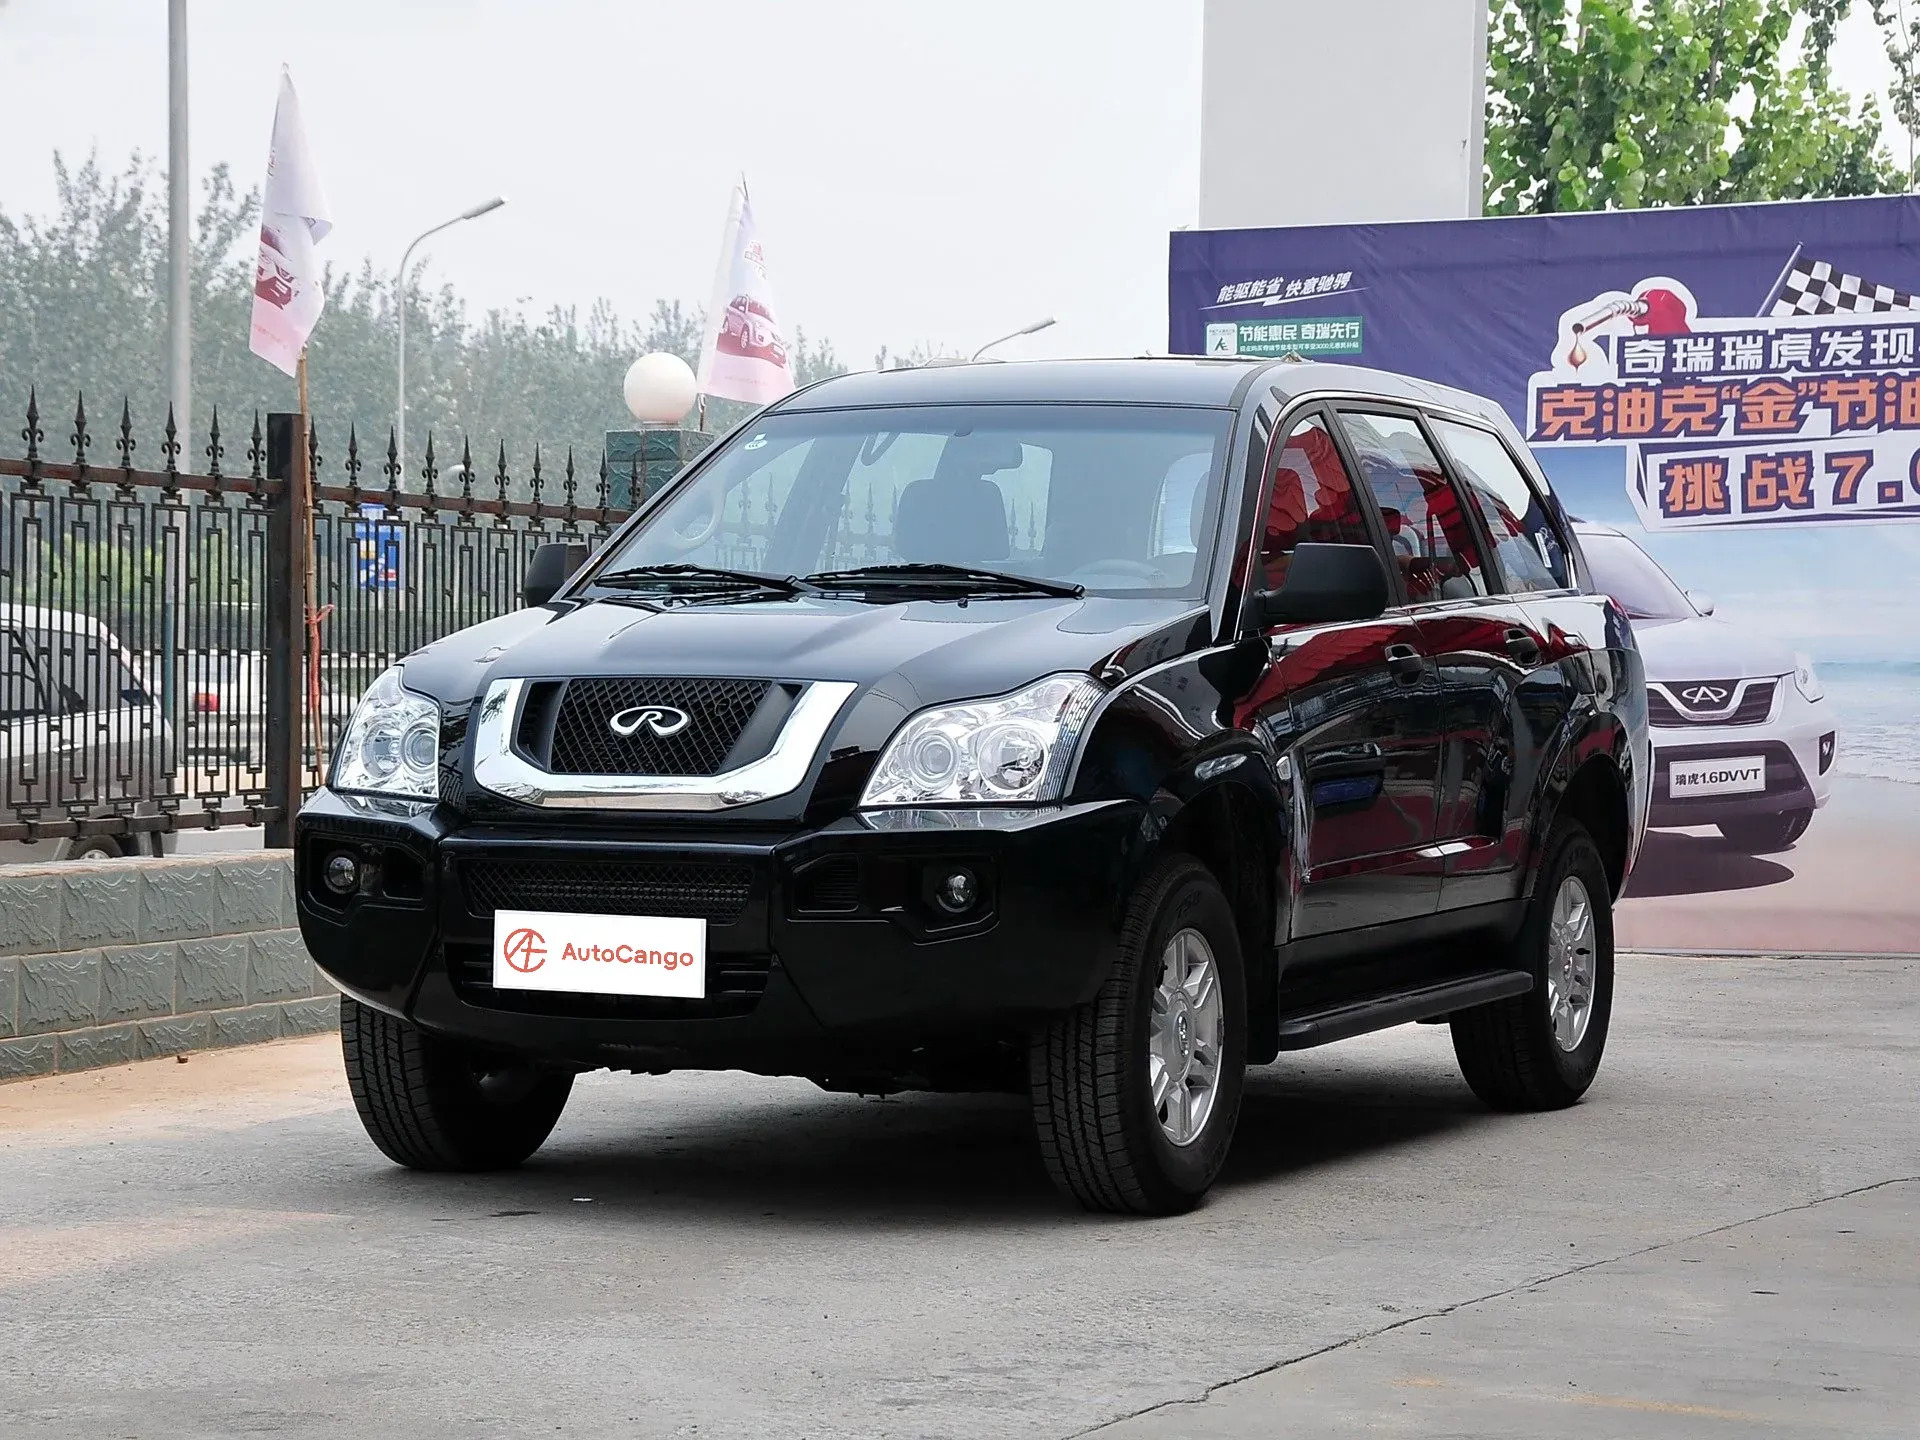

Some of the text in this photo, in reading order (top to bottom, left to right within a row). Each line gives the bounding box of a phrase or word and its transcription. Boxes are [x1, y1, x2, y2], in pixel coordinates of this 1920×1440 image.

[1216, 271, 1352, 303] 能驱能省 快意驰骋
[1239, 323, 1298, 342] 节能惠民
[1301, 321, 1360, 340] 奇瑞先行
[1624, 328, 1920, 374] 奇瑞瑞虎发现
[1665, 456, 1920, 513] 挑战7.
[1675, 768, 1761, 785] 瑞虎1.6DVVT
